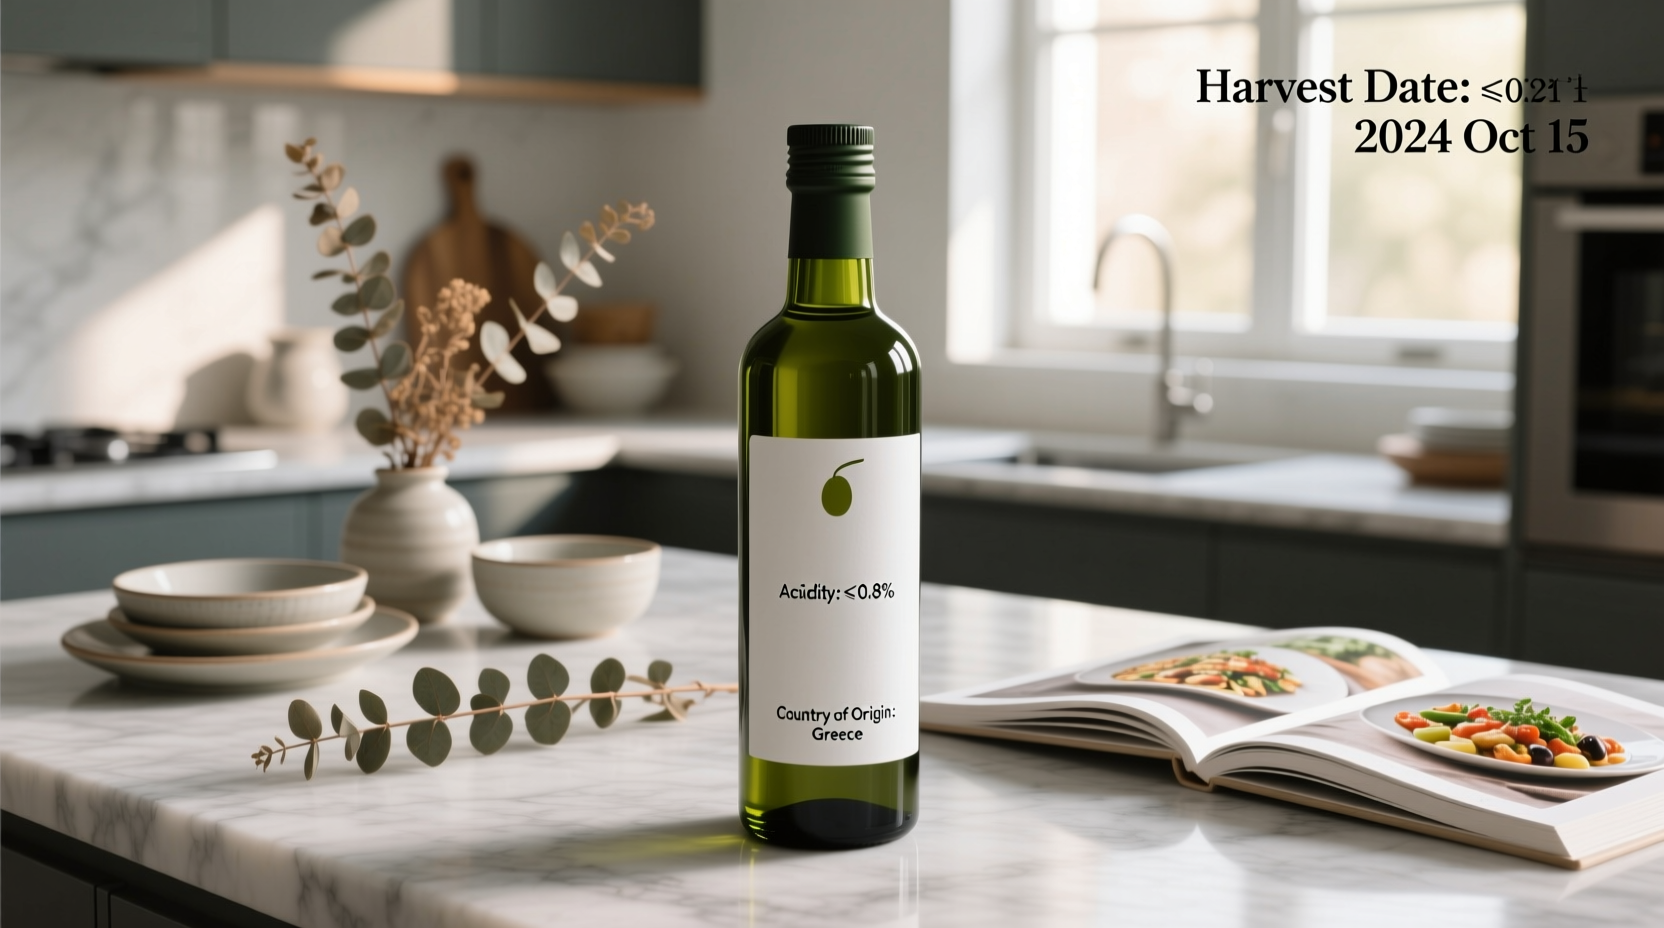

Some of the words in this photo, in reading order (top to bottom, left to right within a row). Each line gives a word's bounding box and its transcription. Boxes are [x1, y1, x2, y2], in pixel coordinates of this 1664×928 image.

[776, 705, 831, 726] Country
[833, 706, 849, 722] of
[851, 704, 896, 724] Origin:
[811, 727, 864, 741] Greece
